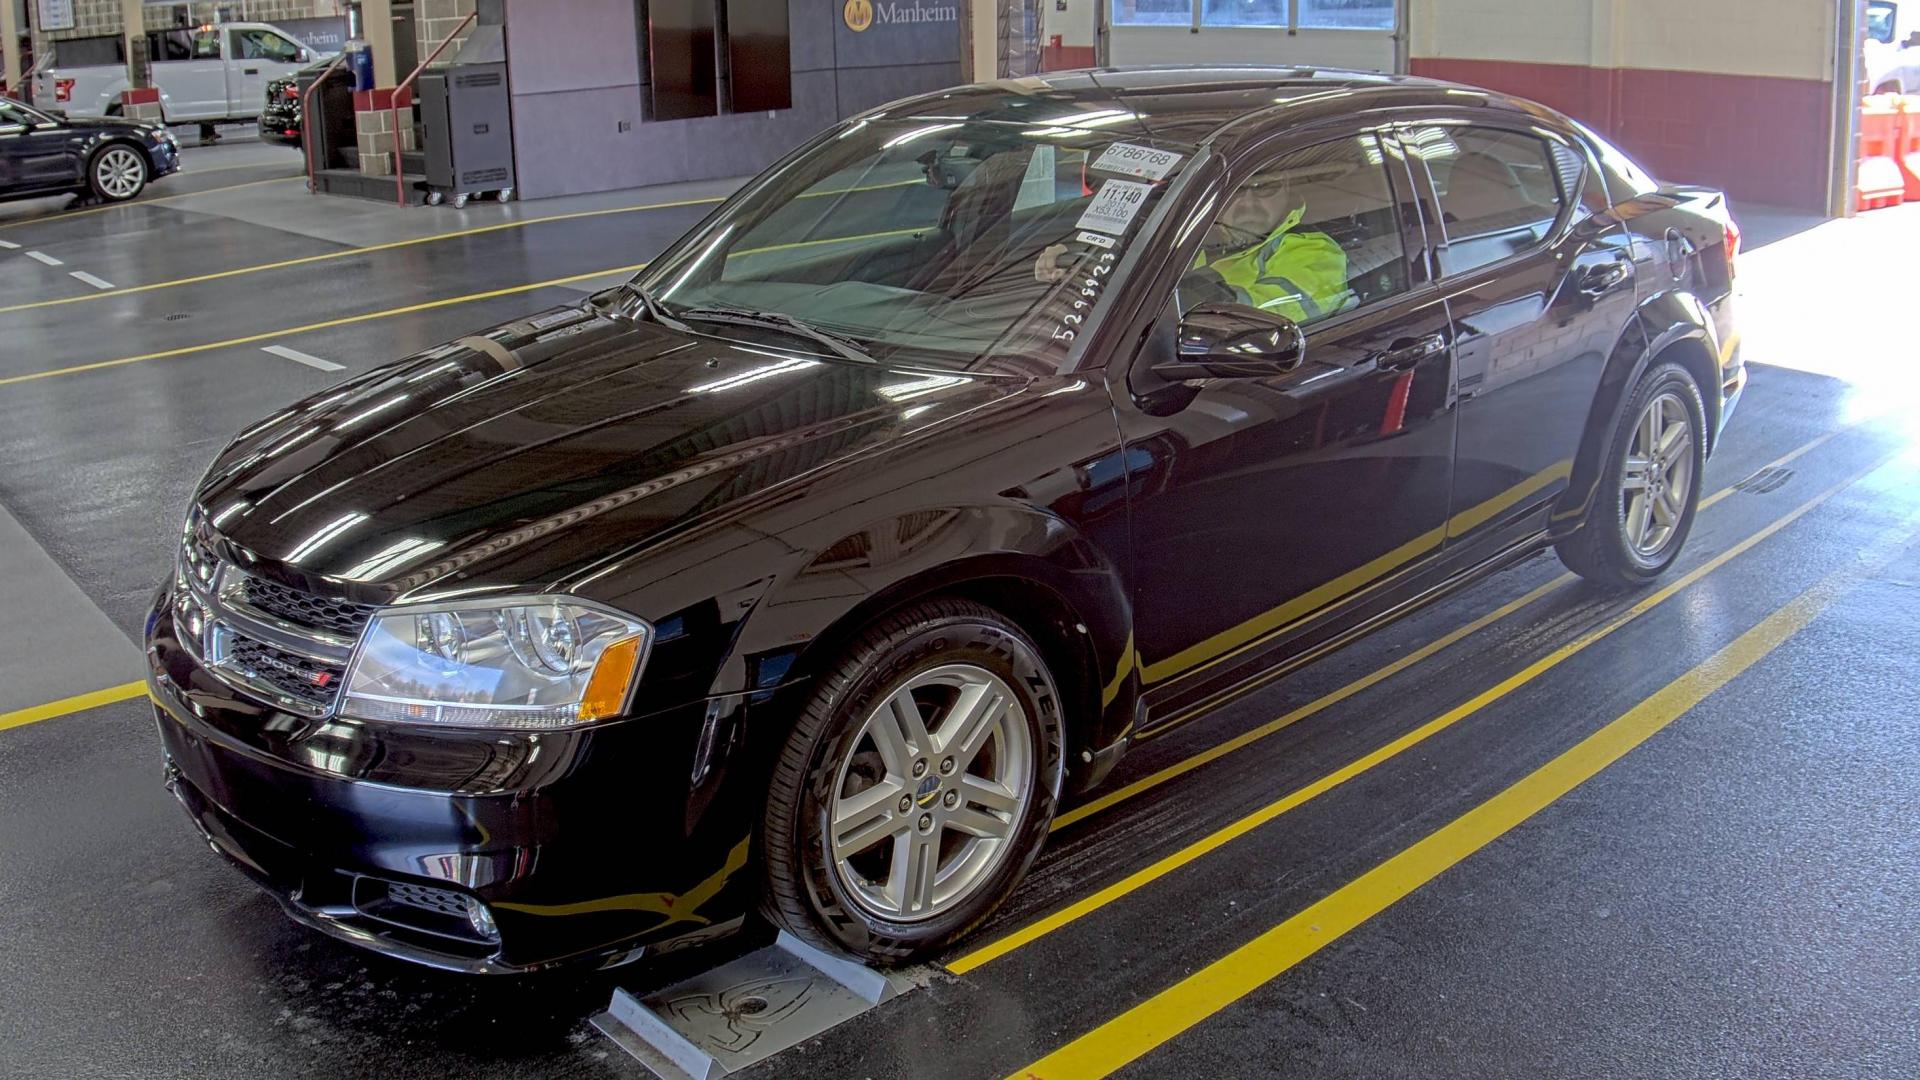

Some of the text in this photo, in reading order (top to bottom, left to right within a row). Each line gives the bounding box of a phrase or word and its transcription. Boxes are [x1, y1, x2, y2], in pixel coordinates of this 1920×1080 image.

[876, 0, 957, 24] Manheim
[1106, 145, 1171, 166] 6786768
[1052, 253, 1115, 341] 5298923
[261, 655, 321, 682] DODGE
[1024, 668, 1061, 768] ZETA
